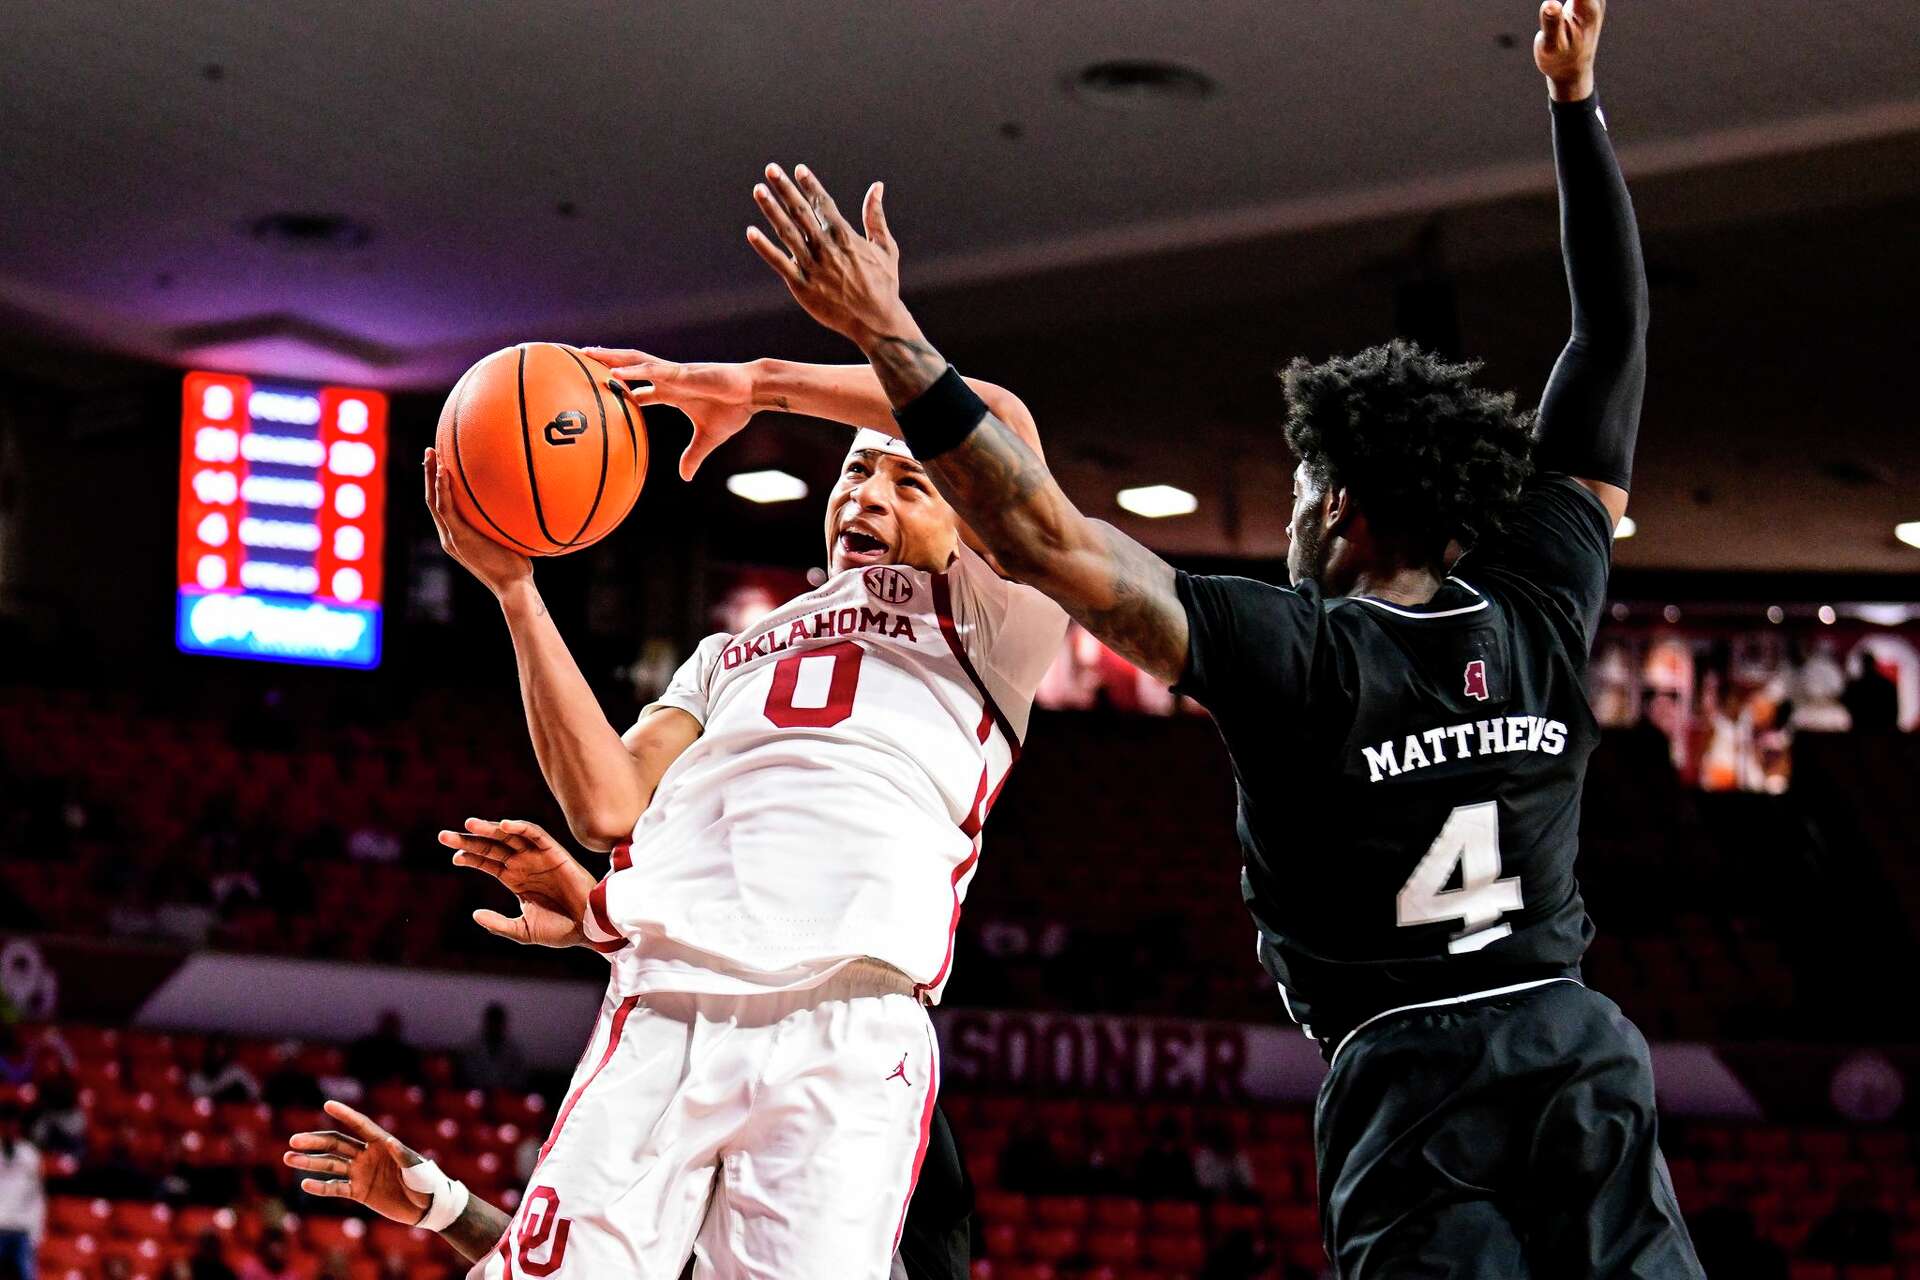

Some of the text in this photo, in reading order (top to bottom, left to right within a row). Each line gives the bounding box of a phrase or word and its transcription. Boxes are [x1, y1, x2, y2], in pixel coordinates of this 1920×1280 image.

[865, 568, 912, 604] SEC
[722, 606, 917, 671] OKLAHOMA
[763, 640, 865, 728] 0
[1396, 800, 1524, 954] 4
[950, 1013, 1248, 1098] SOONER
[517, 1185, 572, 1278] OU
